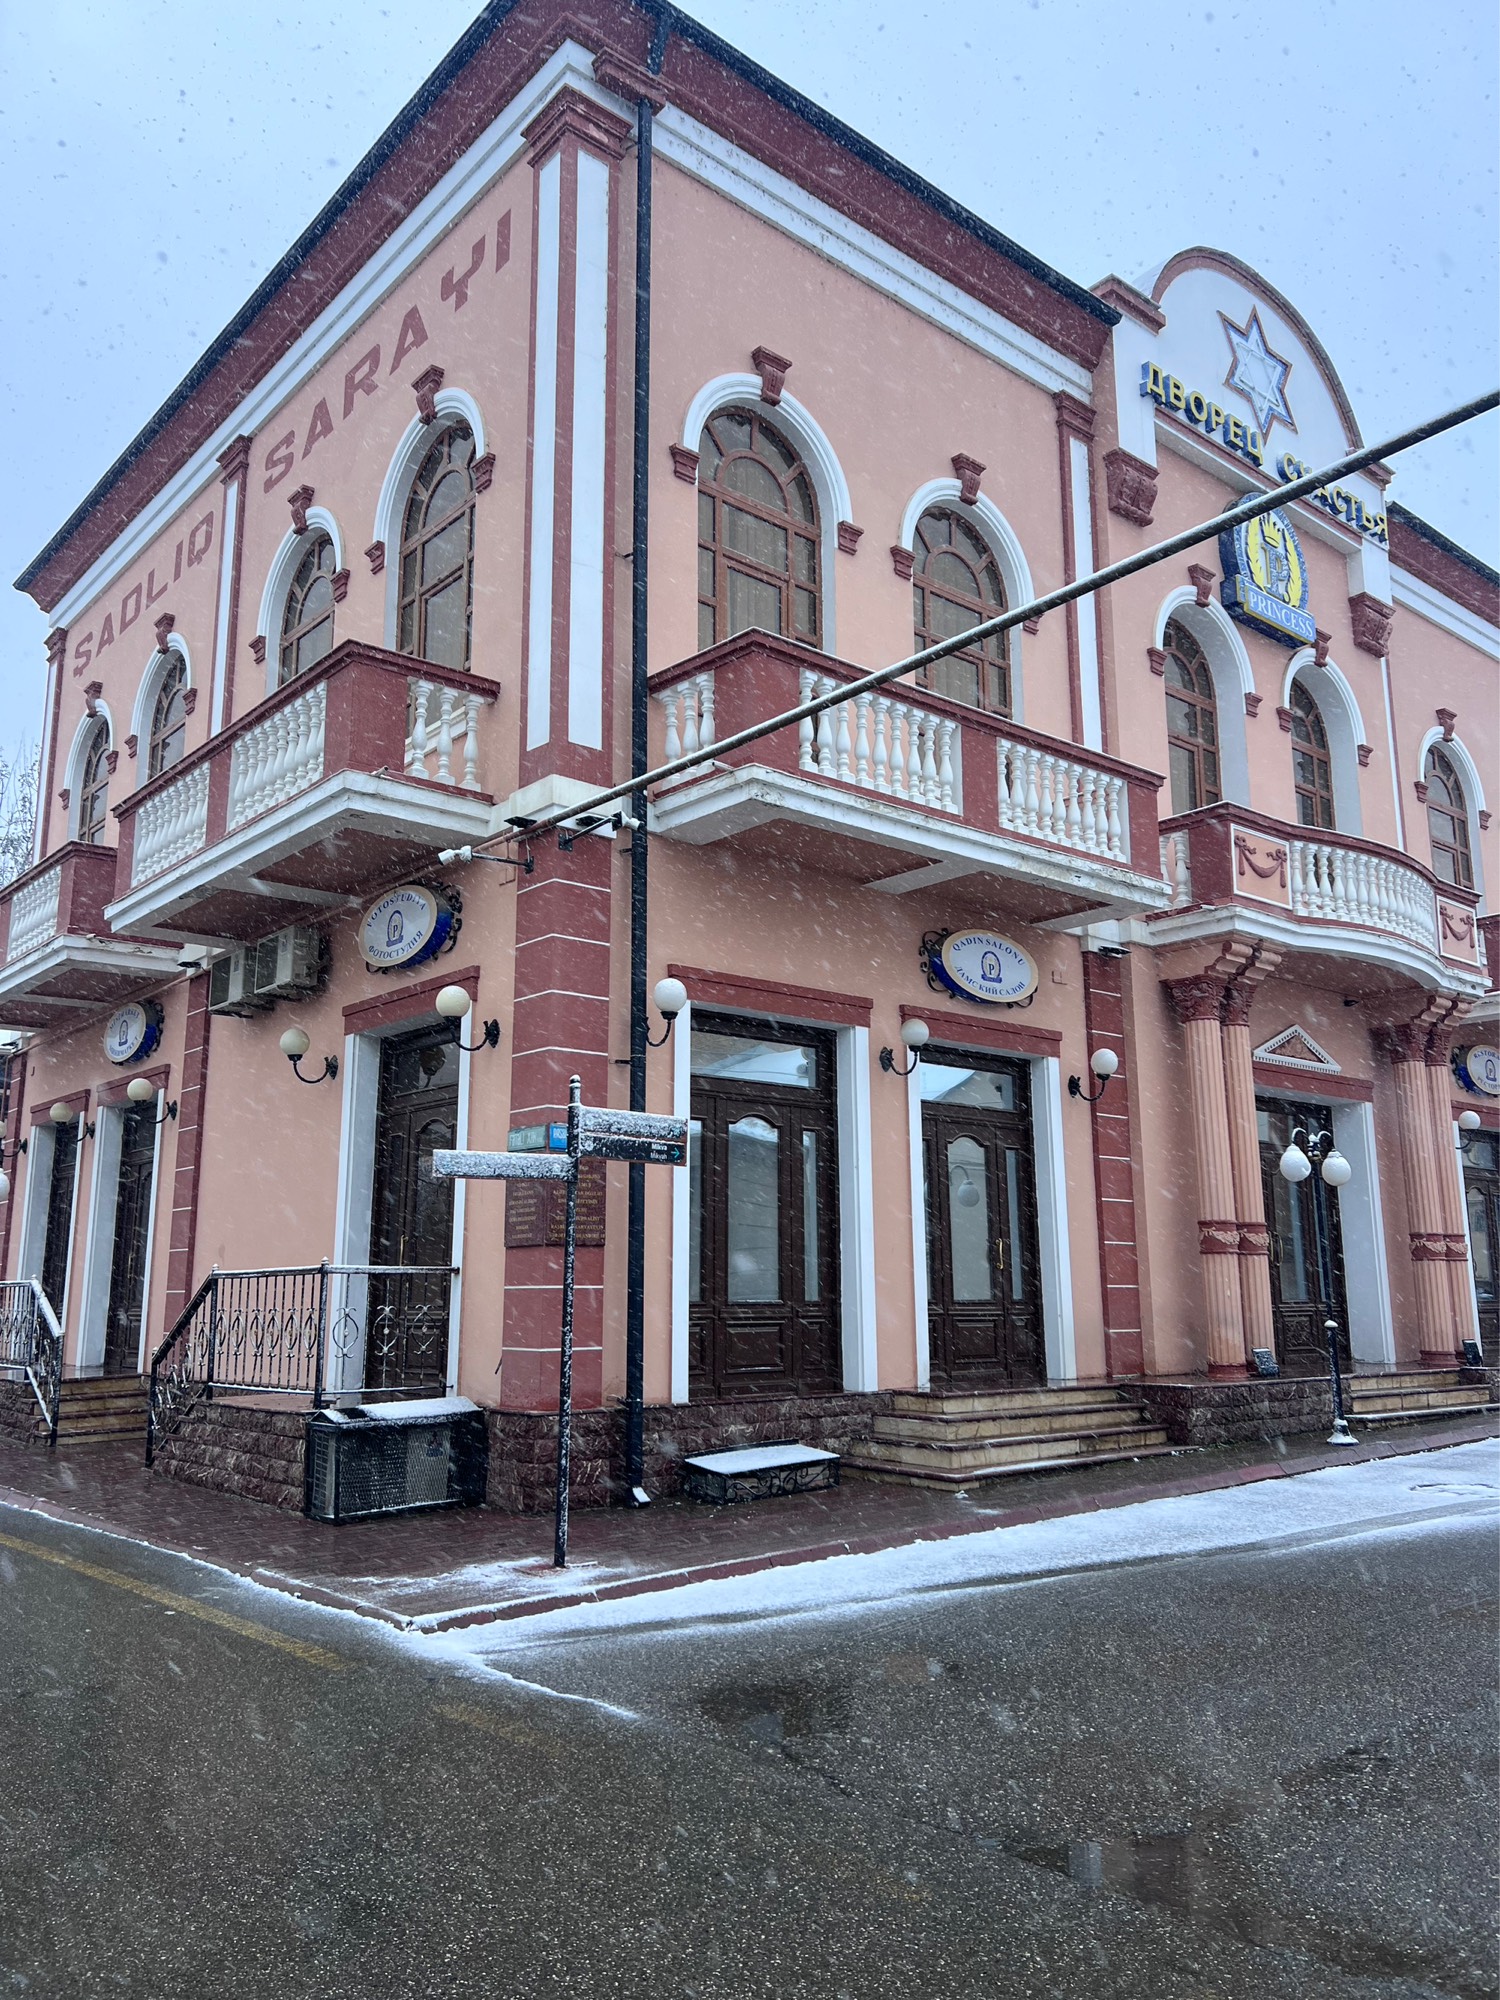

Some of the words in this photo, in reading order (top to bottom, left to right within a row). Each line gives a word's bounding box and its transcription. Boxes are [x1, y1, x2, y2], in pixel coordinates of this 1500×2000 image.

[263, 208, 512, 494] SARAYI
[1140, 361, 1264, 467] ДВОРЕЦ
[1249, 592, 1314, 638] PRINCESS
[368, 930, 424, 959] ФОТОСТУДИЯ
[952, 936, 984, 952] QADIN
[985, 938, 1026, 966] SALONU
[999, 981, 1026, 996] САЛОН
